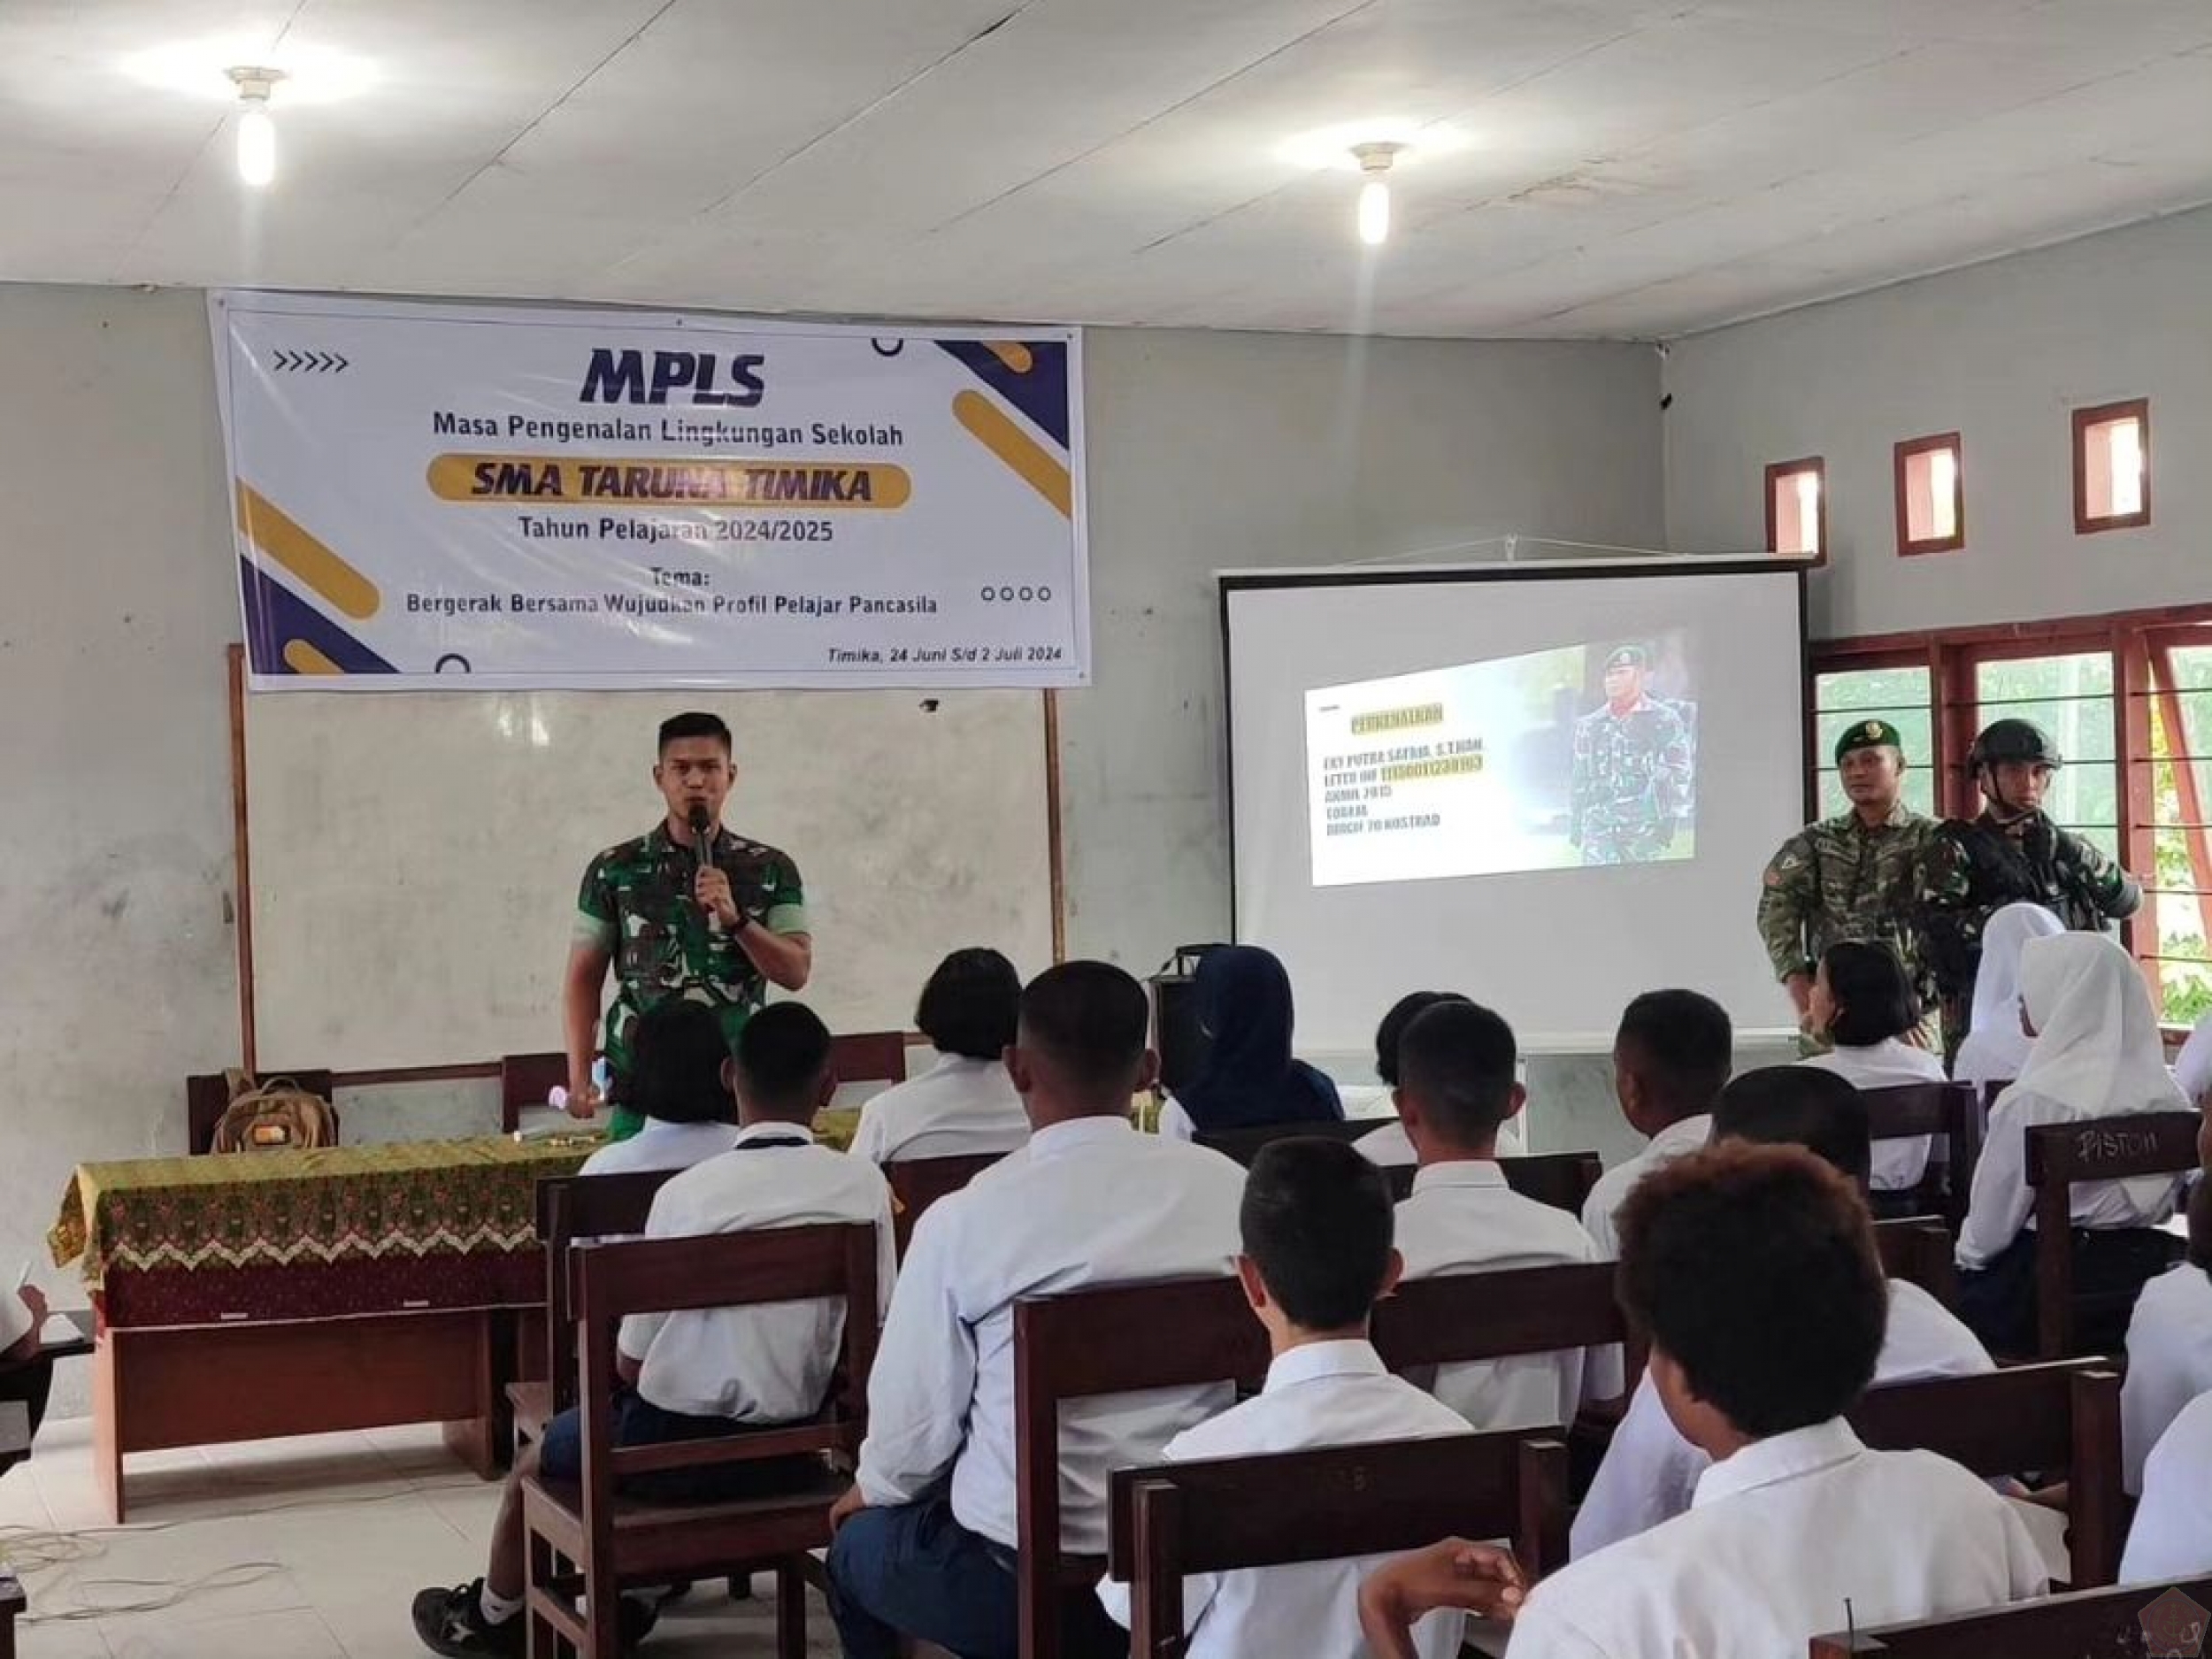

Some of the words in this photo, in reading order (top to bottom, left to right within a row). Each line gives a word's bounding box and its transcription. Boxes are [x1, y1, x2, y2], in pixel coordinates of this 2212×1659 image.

[580, 348, 764, 408] MPLS
[434, 411, 498, 435] Masa
[508, 415, 651, 443] Pengenalan
[662, 419, 803, 447] Lingkungan
[812, 423, 903, 445] Sekolah
[472, 462, 564, 496] SMA
[579, 465, 727, 499] TARUNA
[744, 468, 872, 502] TIMIKA
[518, 515, 589, 538] Tahun
[599, 517, 708, 543] Pelajaran
[715, 519, 833, 541] 2024/2025
[650, 566, 710, 587] Tema:
[407, 593, 503, 616] Bergerak
[511, 593, 599, 613] Bersama
[604, 593, 705, 616] Wujudkan
[714, 595, 767, 614] Profil
[774, 595, 842, 618] Pelajar
[849, 595, 937, 614] Pancasila
[829, 647, 884, 664] Timika,
[890, 647, 908, 662] 24
[913, 646, 947, 663] Juni
[952, 646, 978, 663] S/d
[982, 646, 990, 662] 2
[995, 645, 1023, 663] Juli
[1027, 646, 1062, 662] 2024
